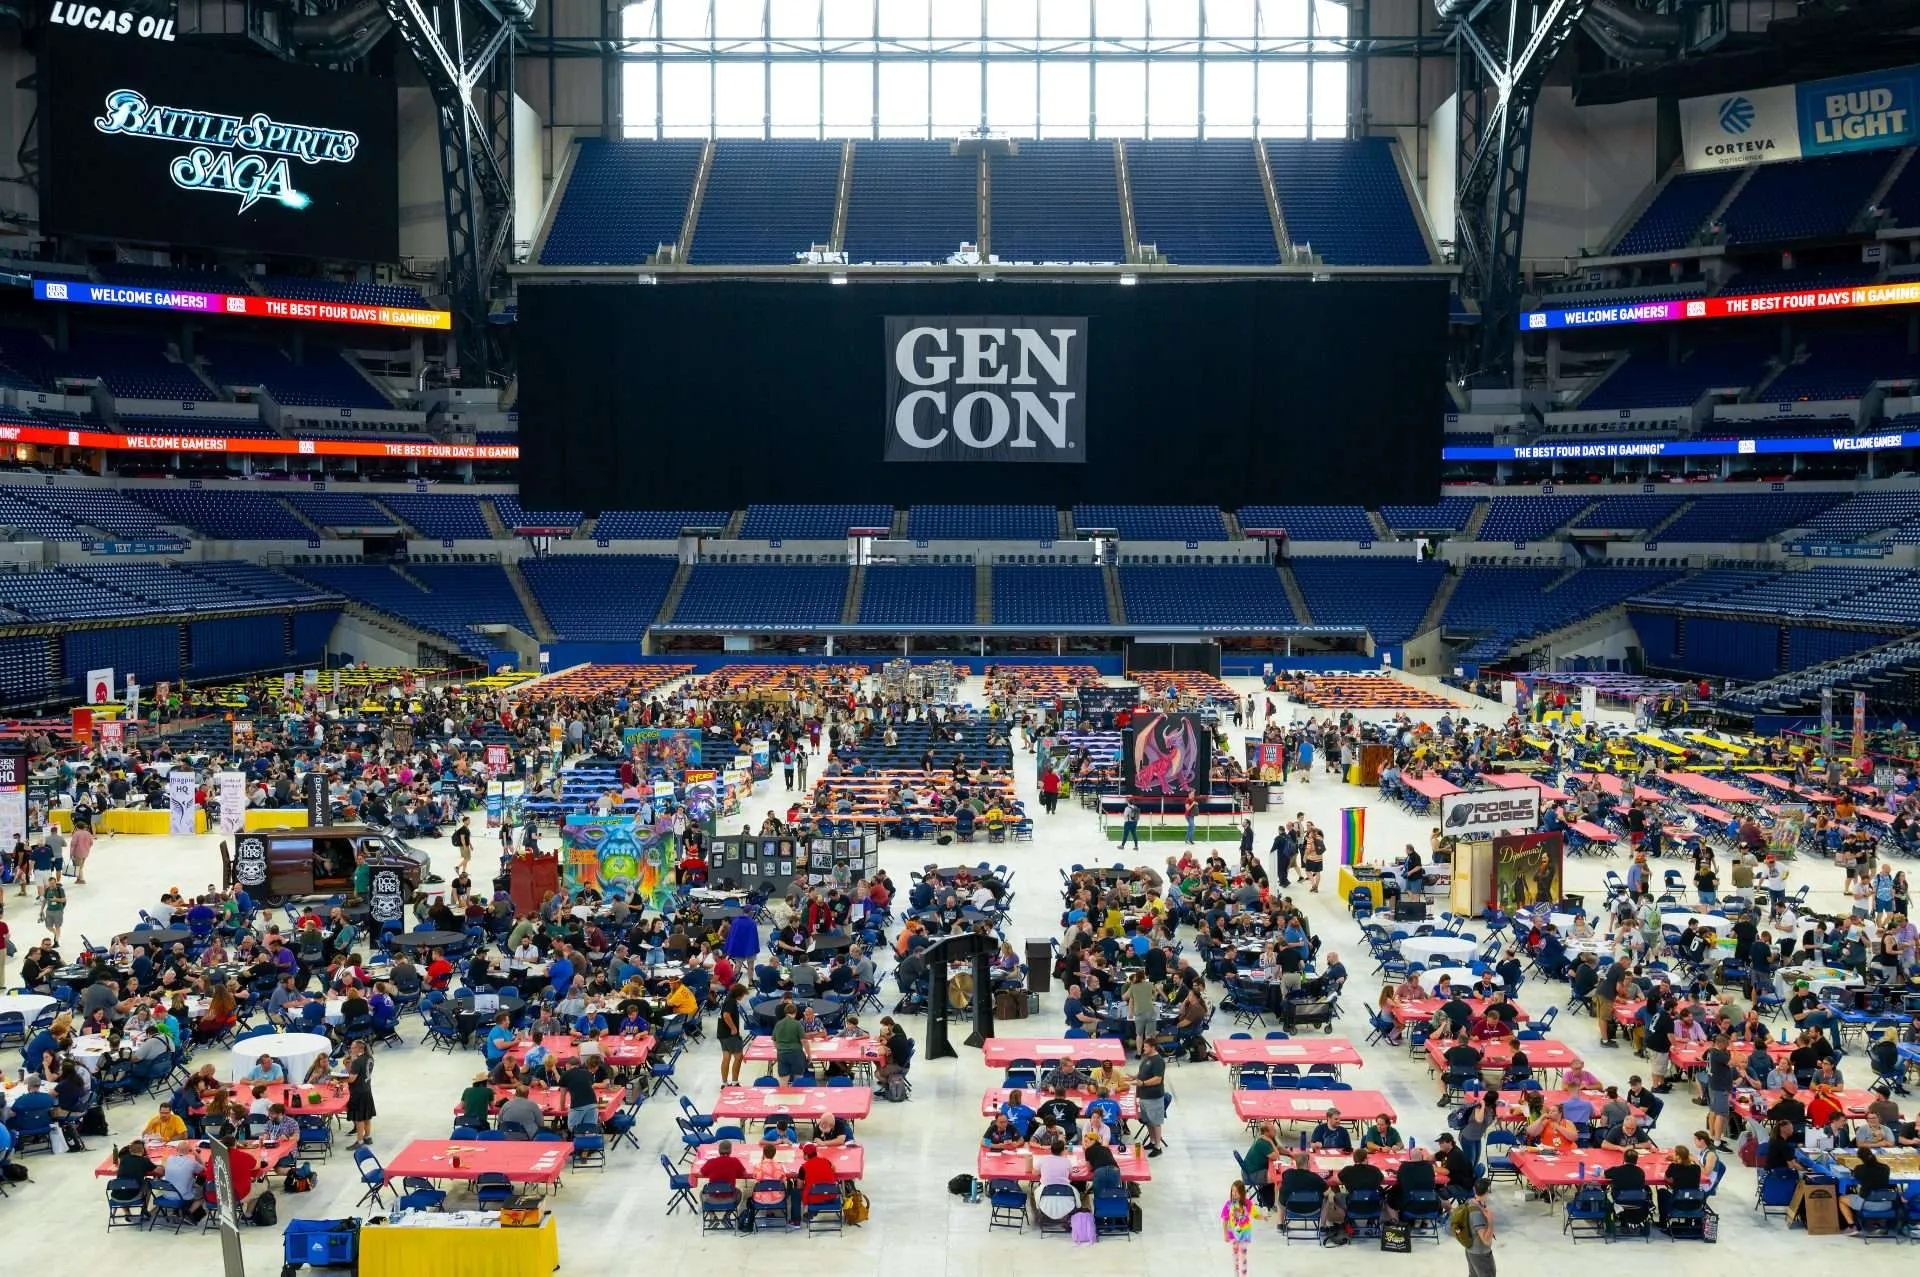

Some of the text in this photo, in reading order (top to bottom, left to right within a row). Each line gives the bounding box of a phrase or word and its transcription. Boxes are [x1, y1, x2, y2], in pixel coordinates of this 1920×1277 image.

[50, 1, 175, 41] LUCAS OIL
[1825, 88, 1893, 119] BUD
[94, 89, 359, 163] BATTLE SPIRITS
[1815, 109, 1907, 144] LIGHT
[1705, 139, 1775, 156] CORTEVA
[1718, 154, 1764, 164] agriscience
[170, 147, 296, 215] SAGA
[91, 288, 207, 309] WELCOME GAMERS!
[1726, 300, 1749, 313] THE
[1751, 297, 1780, 310] BEST
[1783, 294, 1815, 308] FOUR
[1818, 292, 1850, 306] DAYS
[1852, 290, 1865, 303] IN
[266, 301, 287, 314] THE
[290, 303, 317, 317] BEST
[319, 305, 348, 318] FOUR
[350, 307, 376, 320] DAYS
[379, 309, 390, 322] IN
[1564, 305, 1668, 324] WELCOME GAMERS!
[896, 327, 1077, 386] GEN
[895, 390, 1076, 449] CON
[127, 436, 226, 450] WELCOME GAMERS!
[385, 444, 402, 455] THE
[404, 445, 426, 456] BEST
[428, 445, 451, 456] FOUR
[453, 446, 474, 457] DAYS
[477, 447, 486, 457] IN
[1514, 447, 1531, 458] THE
[1533, 447, 1555, 458] BEST
[1557, 446, 1581, 457] FOUR
[1583, 446, 1605, 456] DAYS
[1607, 445, 1618, 456] IN
[1833, 435, 1902, 450] WELCOME GAMERS!
[1474, 799, 1532, 813] ROGUE
[1468, 809, 1534, 825] JUDGES
[243, 844, 260, 852] DCC
[244, 851, 260, 859] RPG
[1500, 846, 1543, 866] Diplomacy
[378, 877, 396, 886] DCC
[378, 884, 396, 893] RPG
